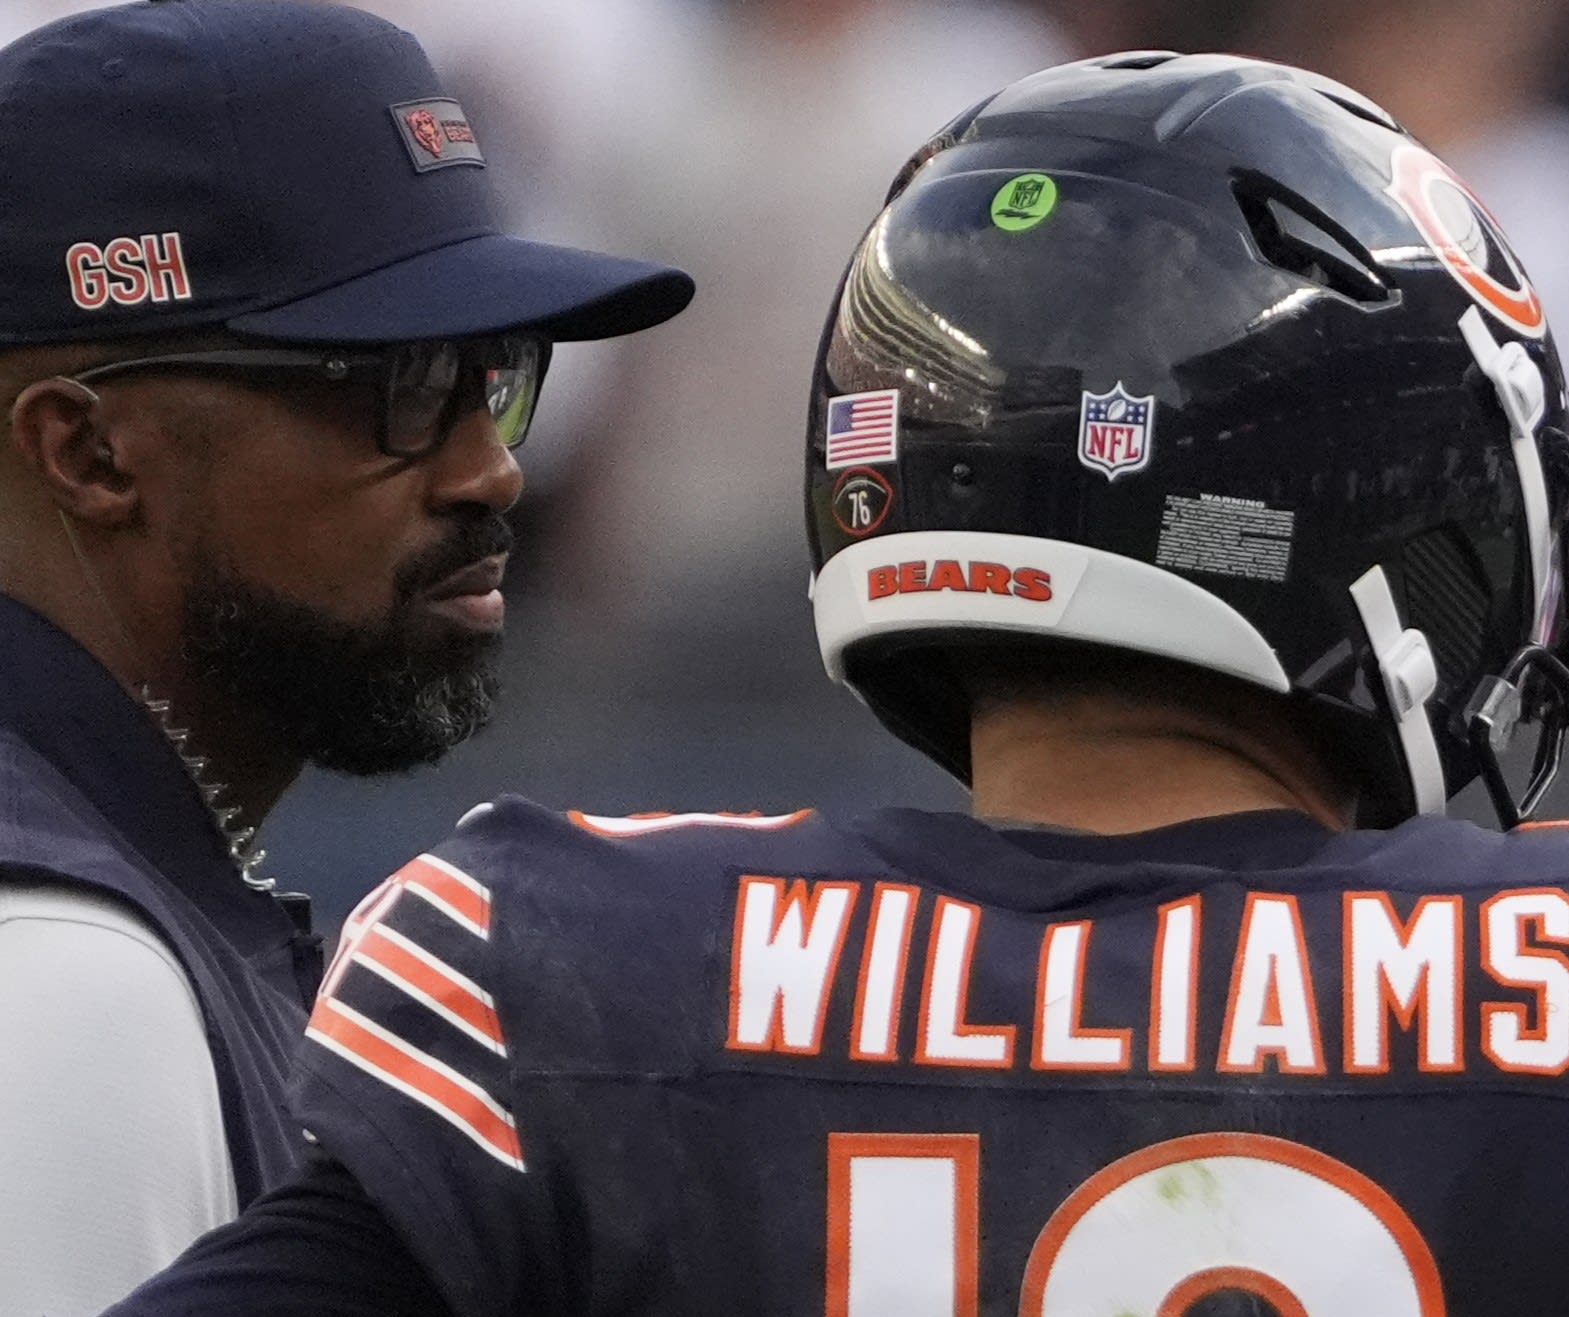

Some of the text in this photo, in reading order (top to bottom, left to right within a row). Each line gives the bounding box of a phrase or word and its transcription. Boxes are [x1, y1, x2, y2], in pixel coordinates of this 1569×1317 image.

[66, 232, 192, 310] GSH
[1088, 424, 1139, 463] NFL
[848, 491, 871, 527] 76
[1200, 493, 1266, 509] WARNING
[868, 560, 1052, 601] BEARS
